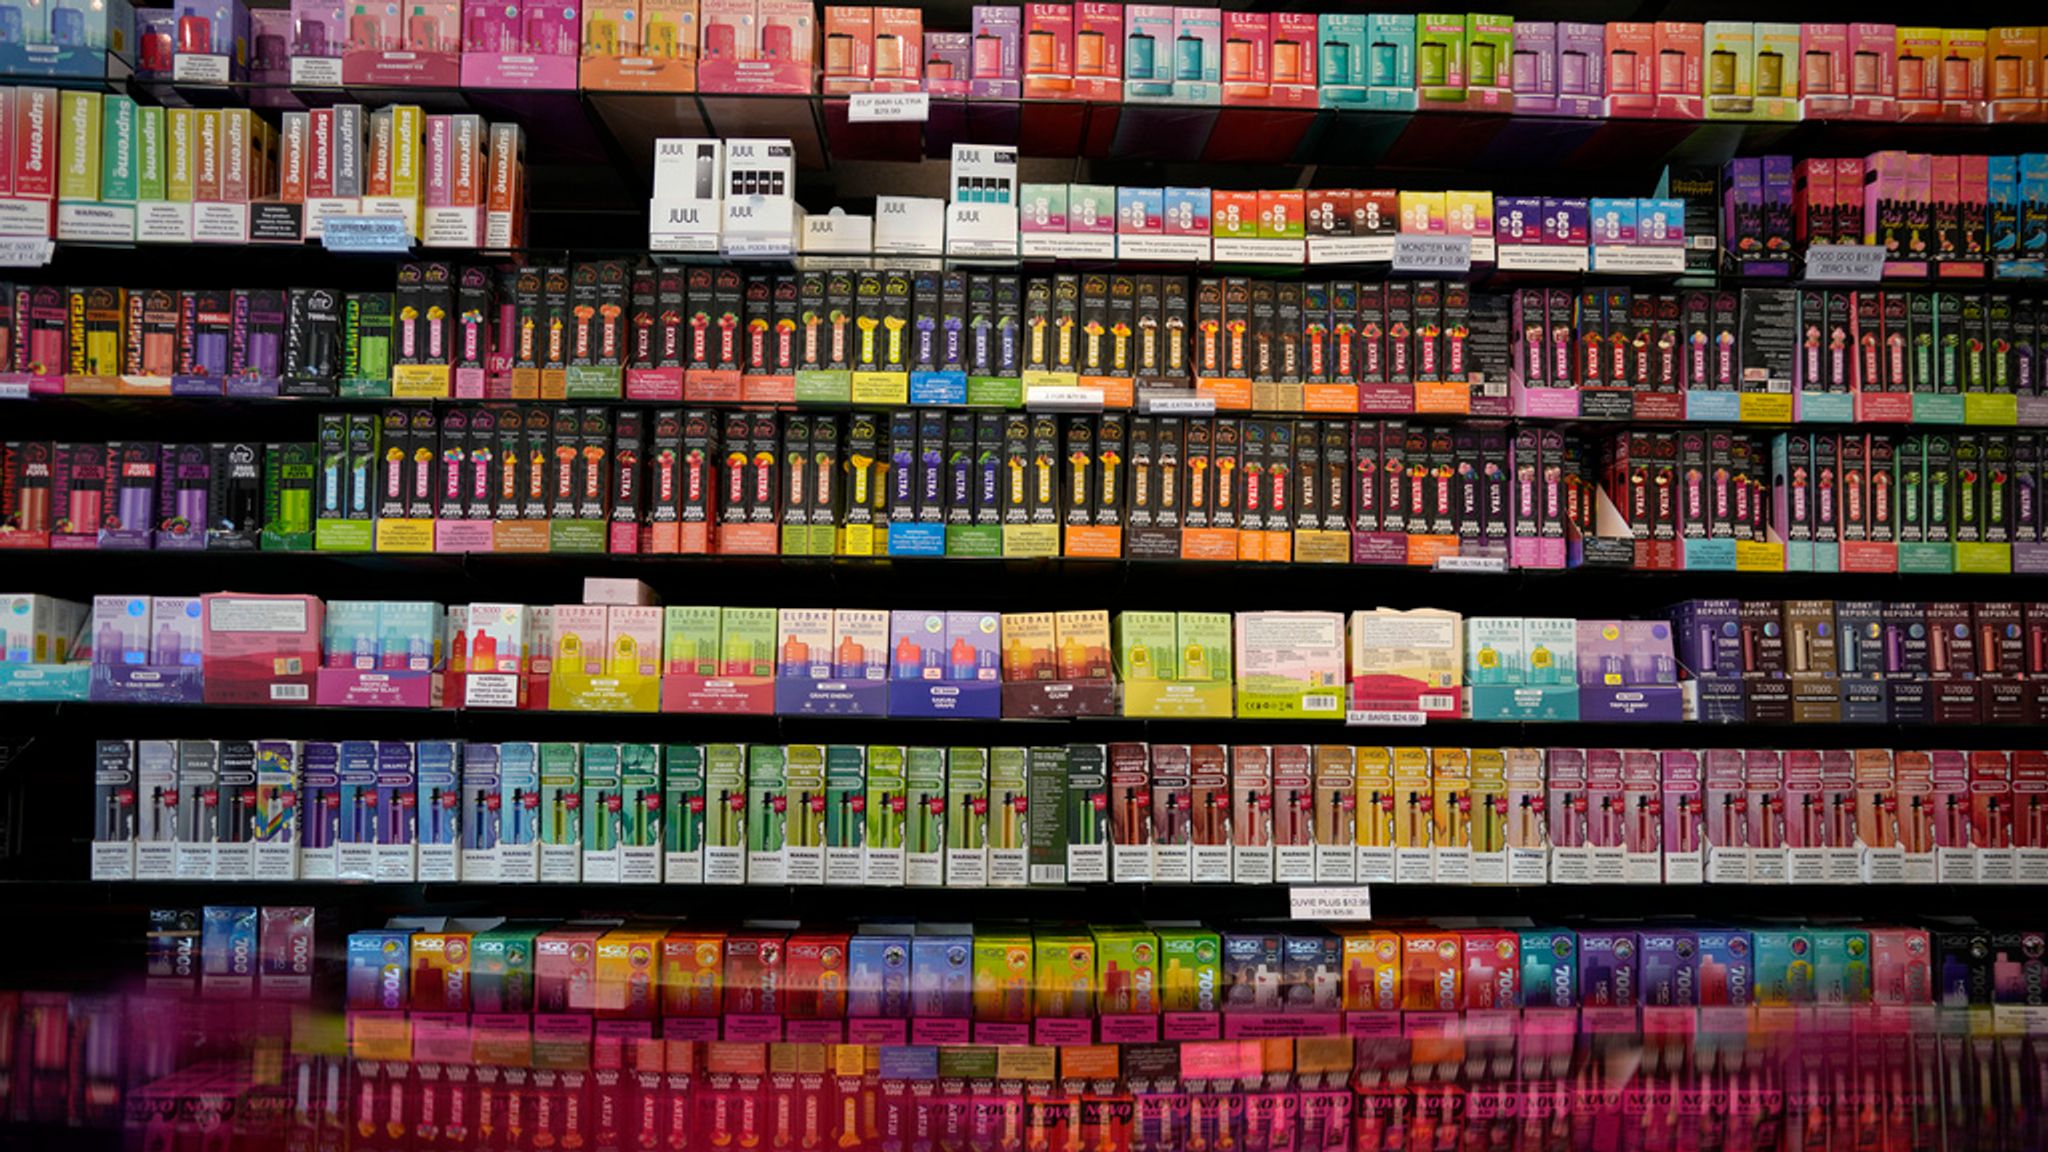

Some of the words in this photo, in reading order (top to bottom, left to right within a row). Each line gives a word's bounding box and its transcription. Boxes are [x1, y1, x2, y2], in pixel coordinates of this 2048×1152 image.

[1033, 5, 1054, 15] ELF
[1084, 3, 1105, 13] ELF
[1231, 13, 1252, 24] ELF
[1280, 14, 1300, 24] ELF
[1427, 16, 1447, 26] ELF
[1476, 15, 1497, 26] ELF
[29, 92, 45, 171] supreme
[72, 97, 87, 175] supreme
[143, 111, 156, 180] supreme
[174, 113, 186, 181] supreme
[202, 114, 215, 181] supreme
[229, 114, 242, 181] supreme
[316, 113, 328, 179] supreme
[342, 109, 353, 177] supreme
[399, 111, 410, 177] supreme
[376, 117, 389, 181] supreme
[459, 119, 471, 187] supreme
[731, 146, 754, 157] JUUL
[497, 128, 509, 193] supreme
[957, 151, 980, 162] JUUL
[730, 206, 752, 217] JUUL
[884, 202, 906, 213] JUUL
[669, 208, 699, 223] JUUL
[957, 211, 979, 222] JUUL
[811, 221, 833, 232] JUUL
[784, 612, 827, 620] ELFBAR
[1061, 614, 1104, 623] ELFBAR
